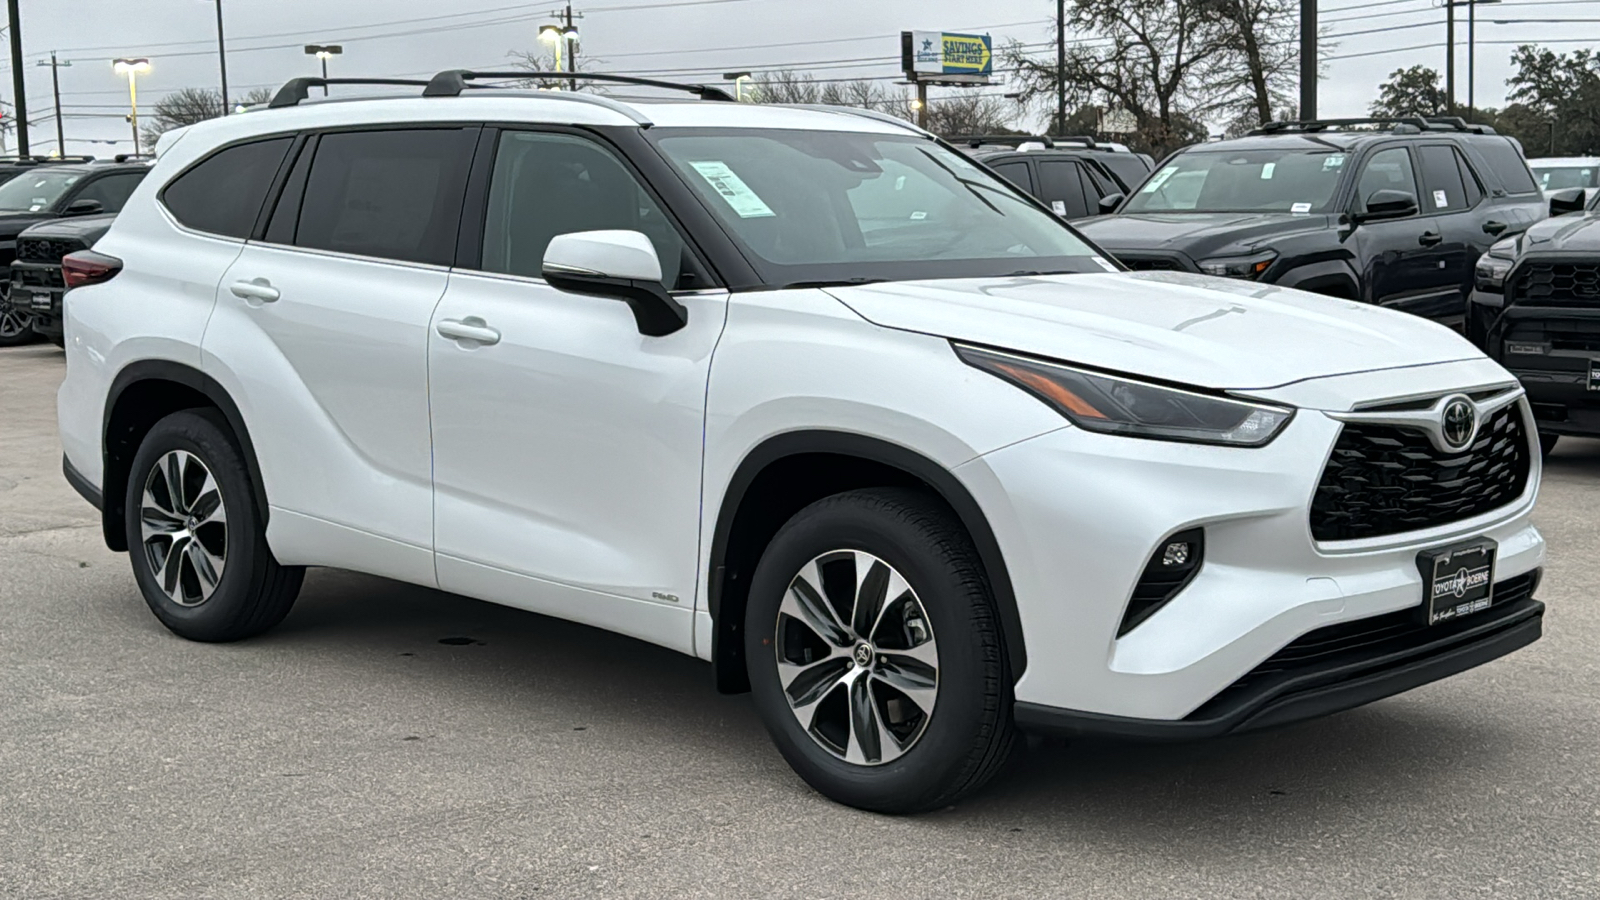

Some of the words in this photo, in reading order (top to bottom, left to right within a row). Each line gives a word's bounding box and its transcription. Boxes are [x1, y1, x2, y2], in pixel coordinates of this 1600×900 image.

[943, 40, 983, 55] SAVINGS
[944, 53, 965, 63] START
[966, 56, 983, 64] HERE
[1434, 580, 1457, 594] TOYOTA
[1466, 570, 1489, 586] BOERNE
